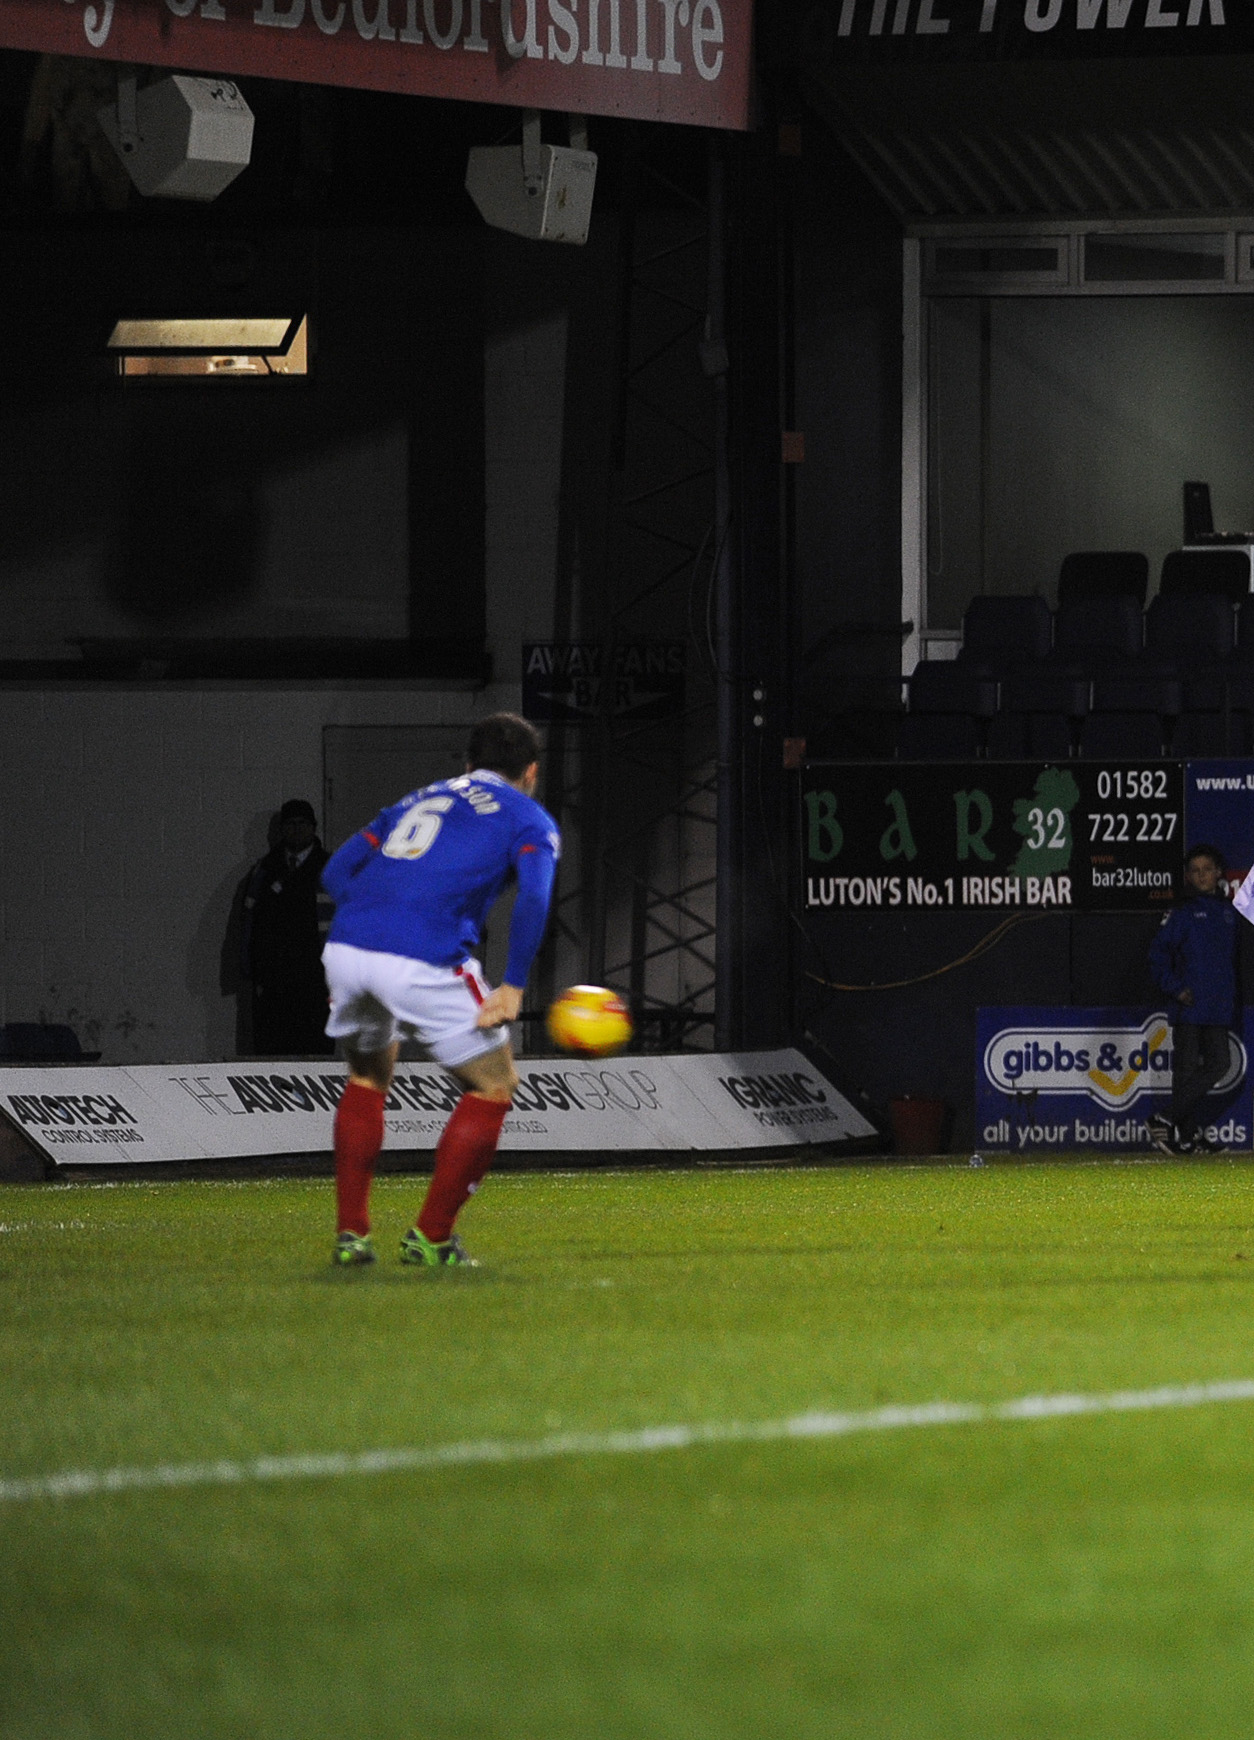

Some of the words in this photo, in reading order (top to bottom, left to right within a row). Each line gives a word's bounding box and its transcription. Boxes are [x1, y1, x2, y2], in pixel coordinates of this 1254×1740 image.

[576, 680, 631, 706] BR
[1096, 770, 1168, 799] 01582
[381, 796, 456, 860] 6
[1026, 807, 1067, 850] 32
[1087, 813, 1130, 842] 722
[1135, 813, 1178, 842] 227
[807, 876, 901, 905] LUTON'S
[906, 876, 955, 906] No.1
[961, 876, 1021, 905] IRISH
[1025, 876, 1073, 905] BAR
[1091, 866, 1173, 888] bar32luton
[1003, 1041, 1090, 1079] gibbs
[1096, 1042, 1123, 1072] &
[6, 1094, 138, 1126] AUTOTECH
[983, 1118, 1009, 1143] all
[1016, 1124, 1069, 1149] your
[1074, 1118, 1152, 1143] buildin
[1196, 1118, 1247, 1143] eds
